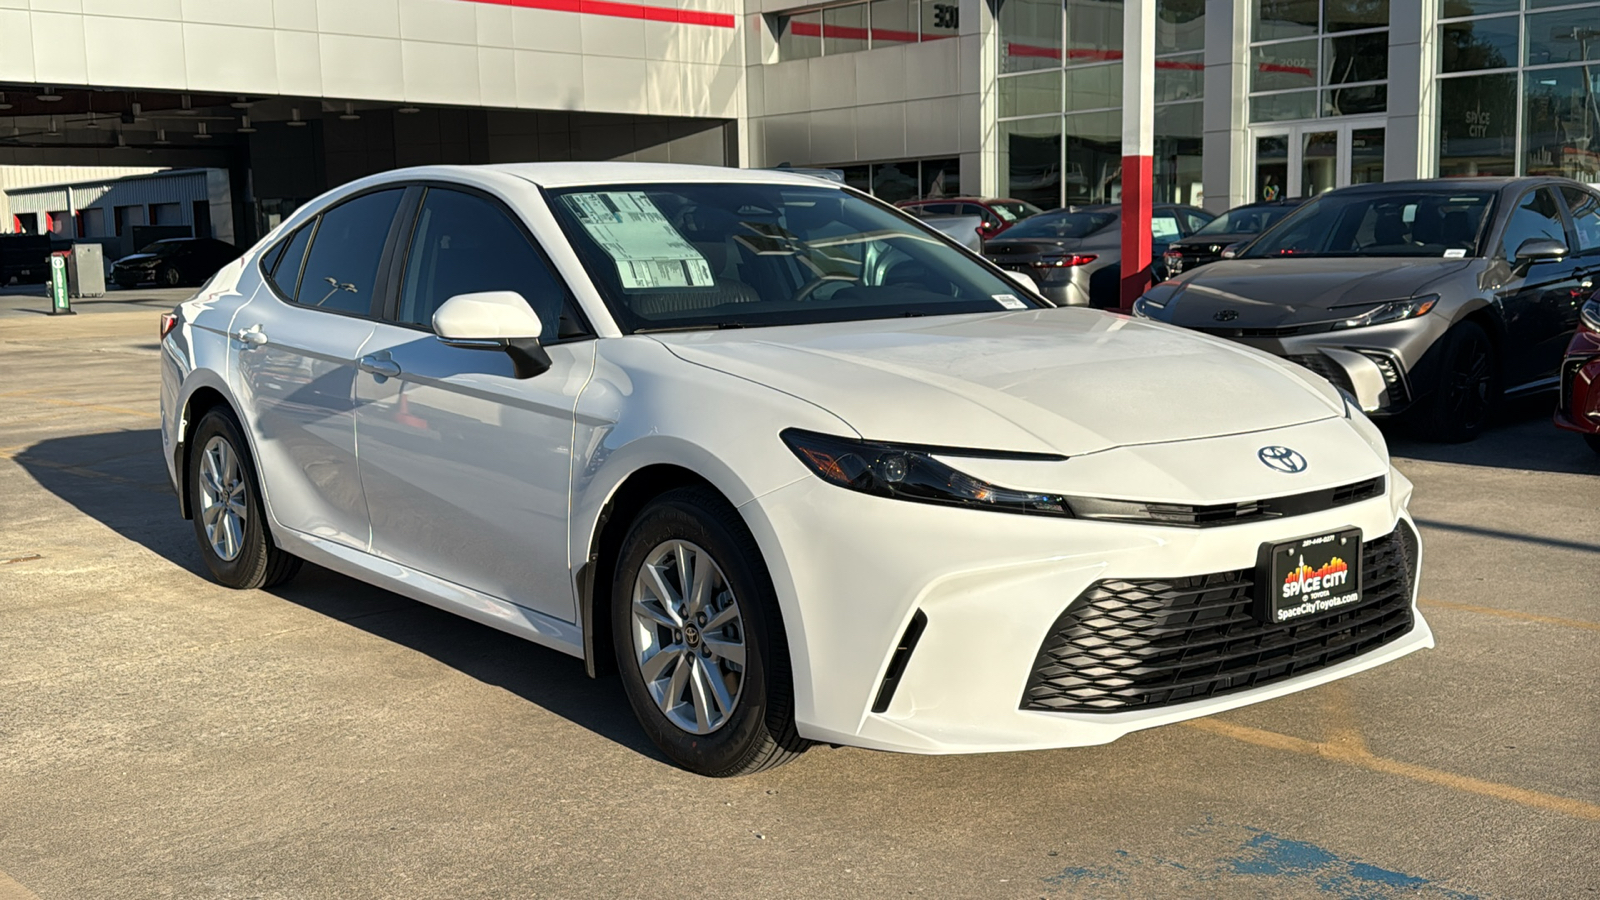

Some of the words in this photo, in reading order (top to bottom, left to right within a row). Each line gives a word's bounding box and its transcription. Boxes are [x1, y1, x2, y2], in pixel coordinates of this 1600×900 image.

[1280, 58, 1306, 68] 2002
[1465, 109, 1490, 125] SPACE
[1469, 125, 1487, 138] CITY
[1282, 576, 1321, 598] SPACE
[1322, 569, 1348, 588] CITY
[1310, 590, 1330, 600] TOYOTA
[1277, 592, 1358, 621] SpaceCityToyota.com
